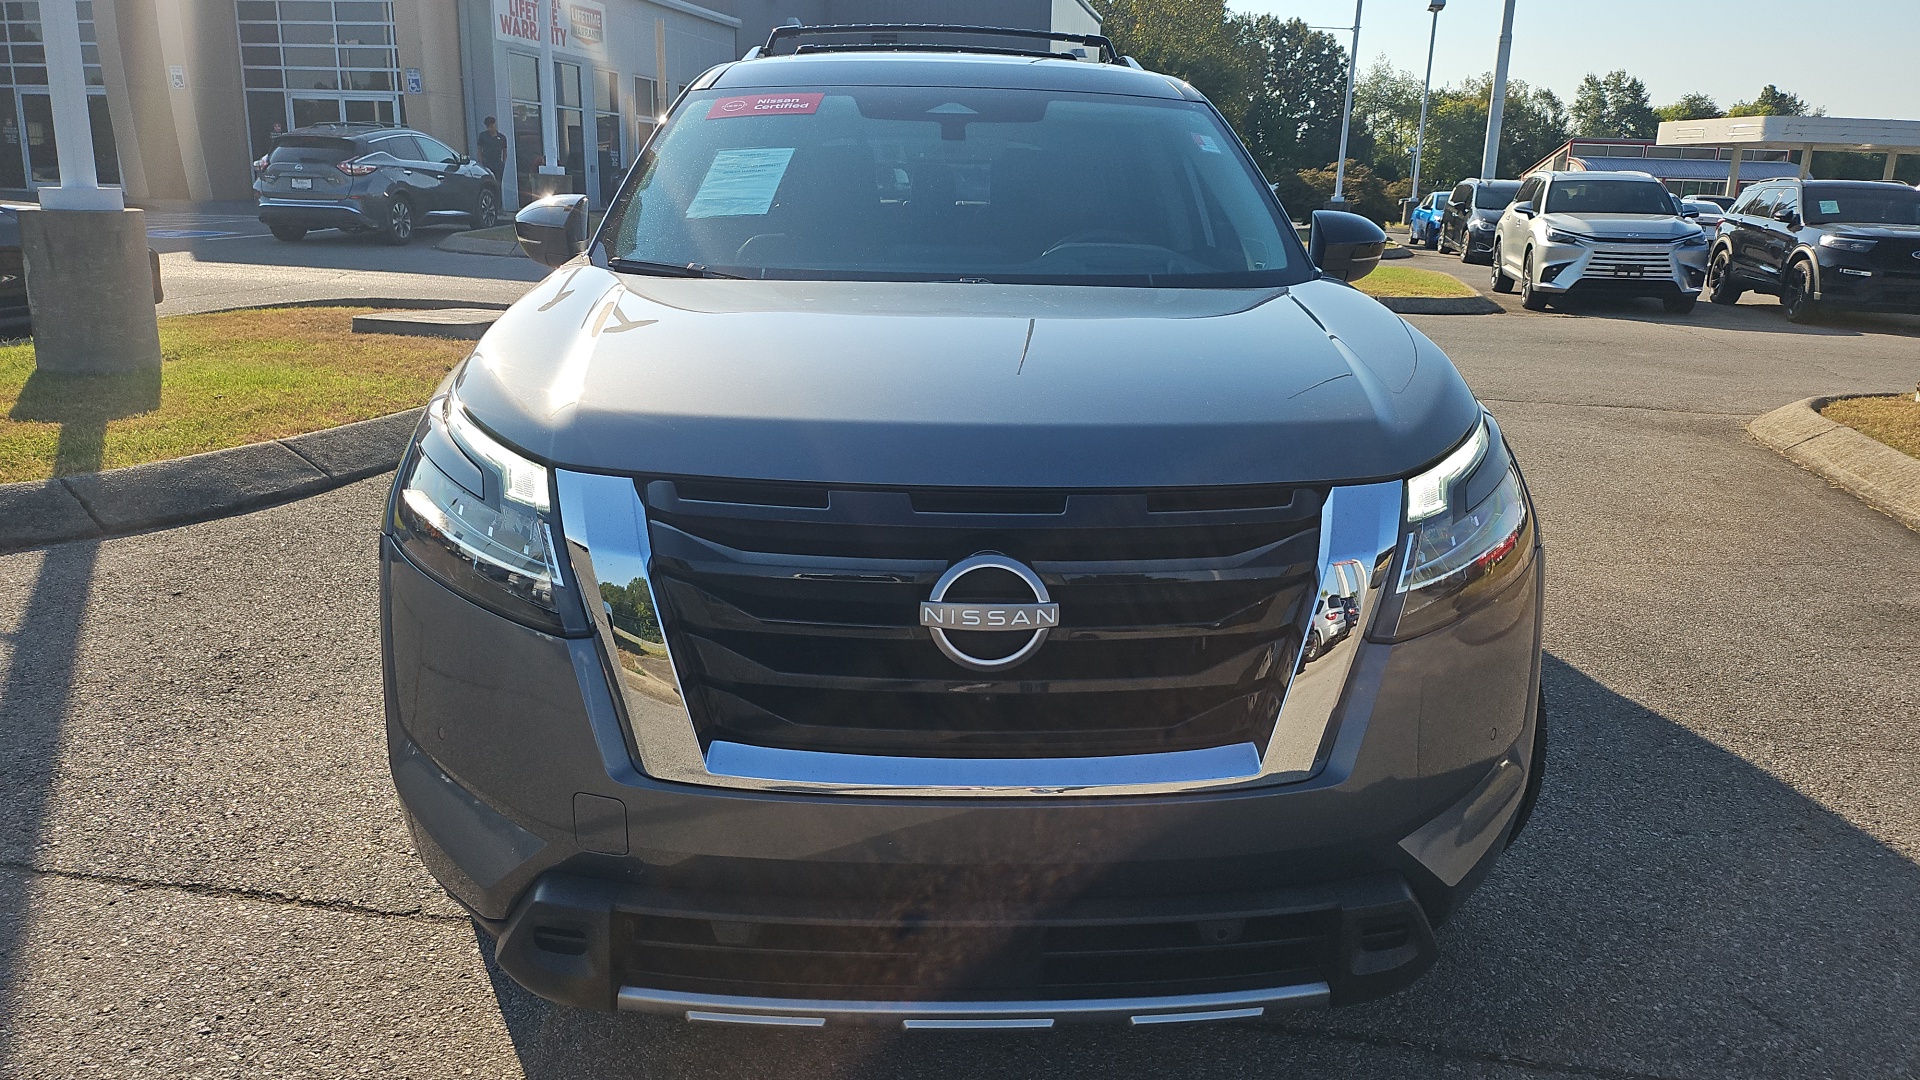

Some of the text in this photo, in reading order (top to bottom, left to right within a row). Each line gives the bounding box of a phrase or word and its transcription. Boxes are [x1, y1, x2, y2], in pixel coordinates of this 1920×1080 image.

[508, 0, 558, 27] LIFETE
[571, 7, 601, 27] LIFETIME
[499, 13, 567, 47] WARRTY
[754, 102, 809, 110] Certified
[924, 607, 1055, 626] NISSAN
